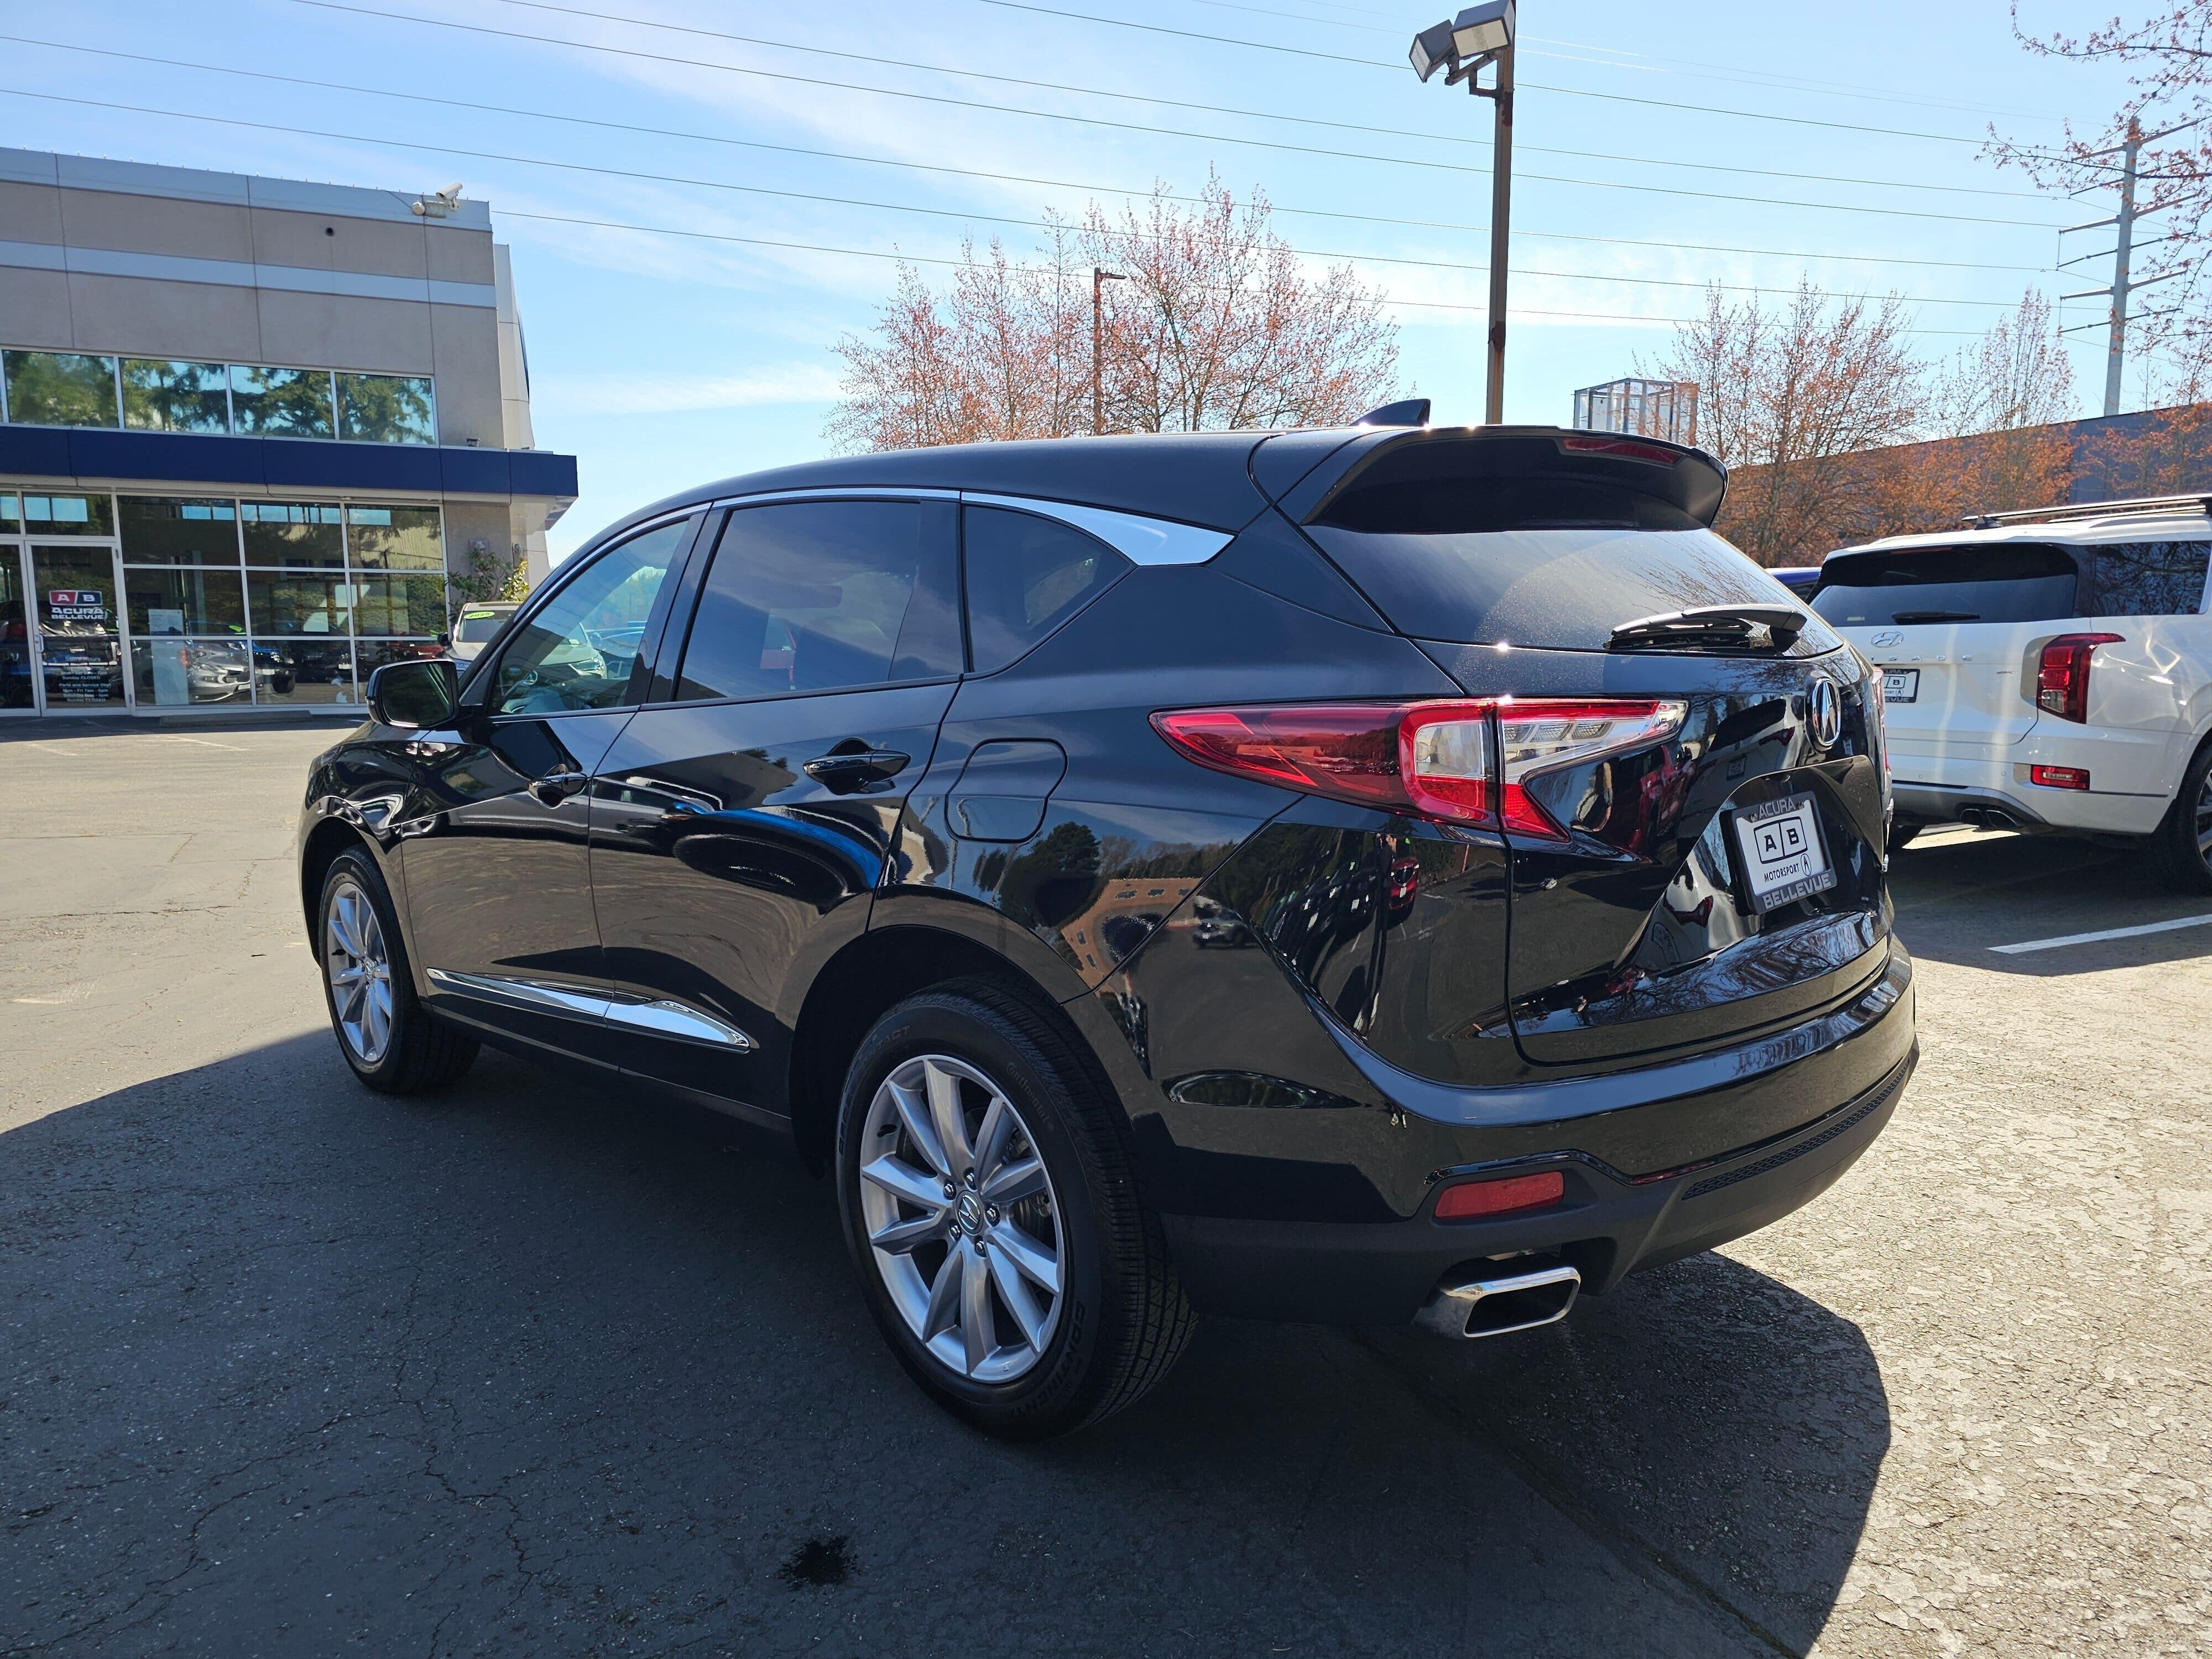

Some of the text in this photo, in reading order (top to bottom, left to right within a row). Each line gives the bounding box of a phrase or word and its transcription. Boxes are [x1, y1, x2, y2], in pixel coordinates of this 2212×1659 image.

[1758, 797, 1796, 820] ACURA
[1764, 828, 1799, 852] A B
[1764, 863, 1800, 883] MOTORSPORT
[1762, 873, 1832, 910] BELLEVUE
[1006, 1062, 1051, 1123] Continental
